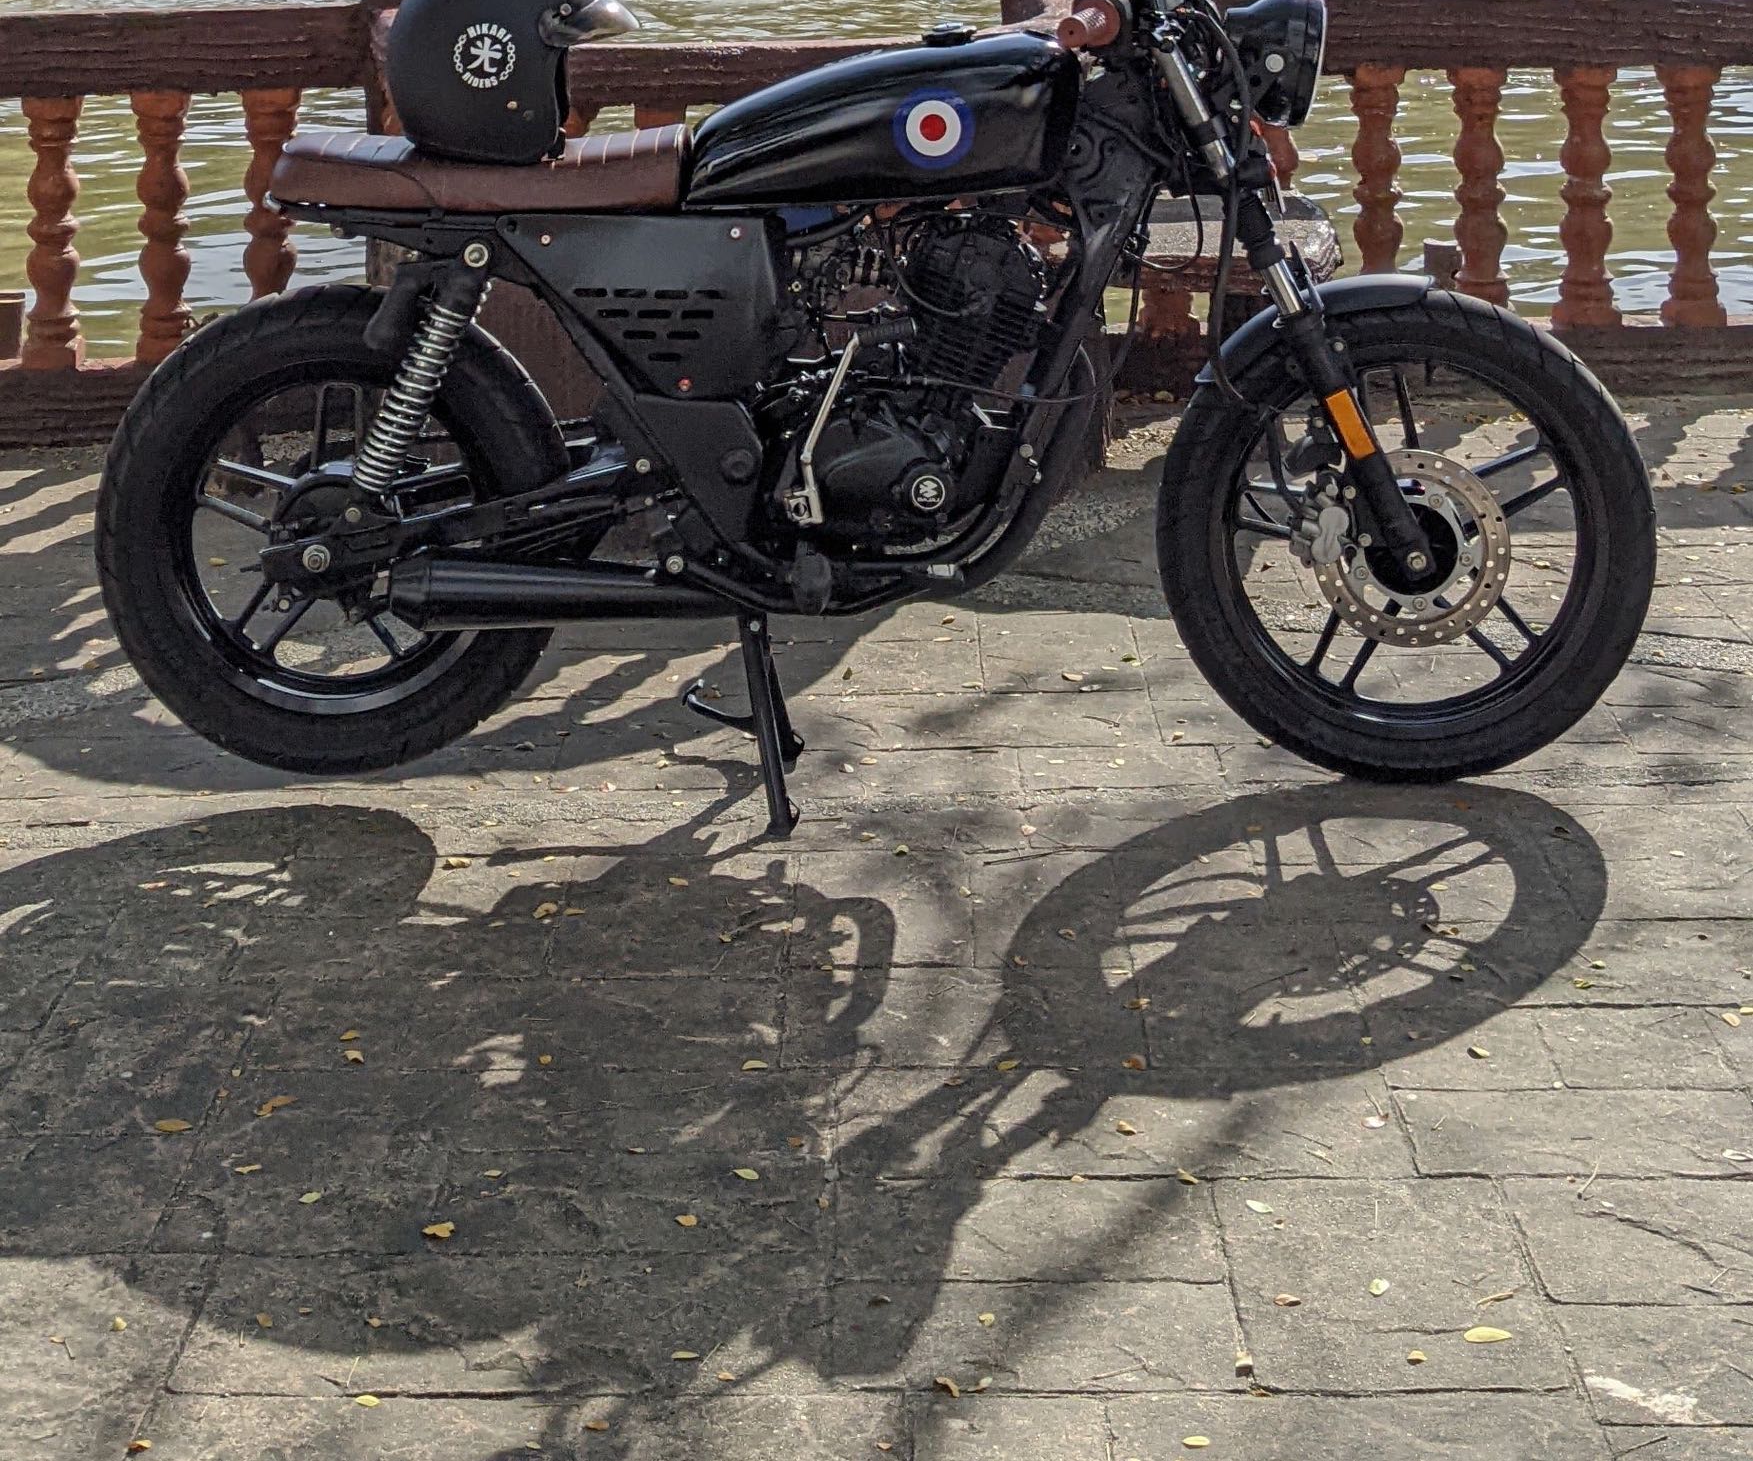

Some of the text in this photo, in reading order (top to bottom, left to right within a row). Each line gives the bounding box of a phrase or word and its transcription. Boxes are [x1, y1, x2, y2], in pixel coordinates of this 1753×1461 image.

[466, 23, 513, 43] HIKARI
[466, 36, 503, 73] 光
[462, 72, 499, 89] RIDERS
